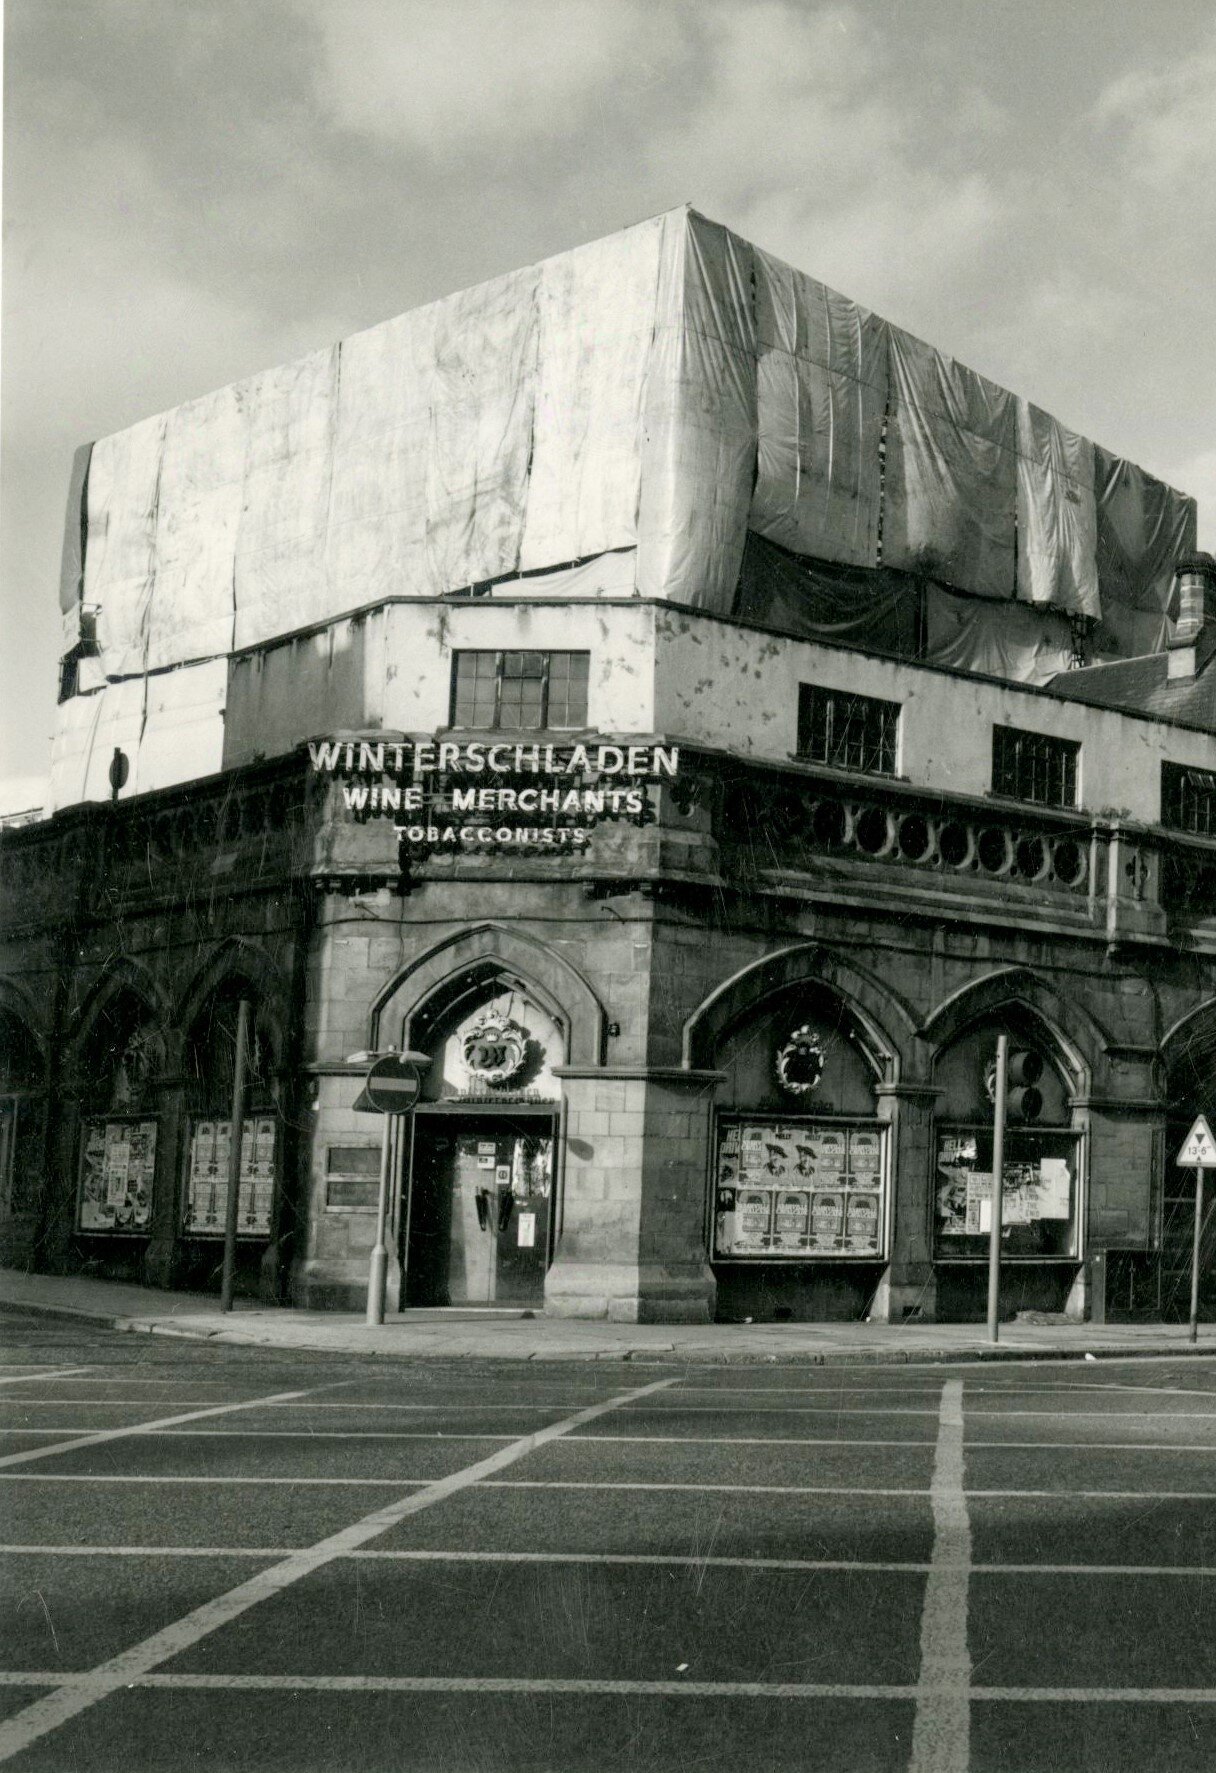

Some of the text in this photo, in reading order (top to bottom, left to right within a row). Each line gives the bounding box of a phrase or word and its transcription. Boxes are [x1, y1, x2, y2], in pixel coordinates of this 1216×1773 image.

[307, 742, 679, 776] WINTERSCHLADEN
[343, 786, 644, 814] WINE MERCHANTS
[393, 825, 586, 845] TOBACCONISTS
